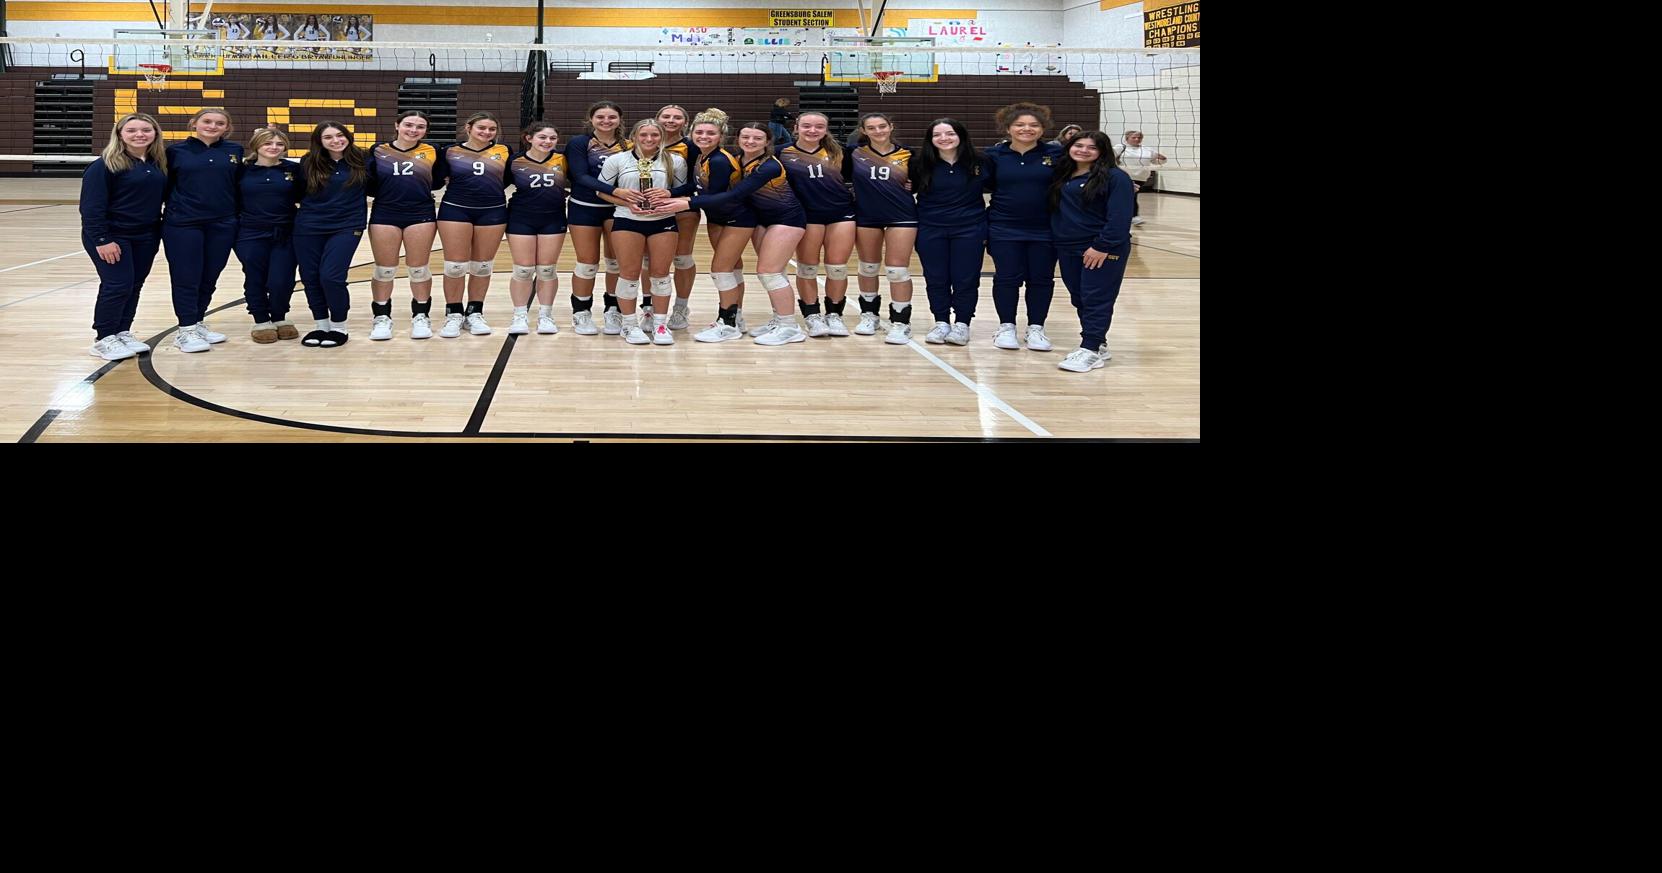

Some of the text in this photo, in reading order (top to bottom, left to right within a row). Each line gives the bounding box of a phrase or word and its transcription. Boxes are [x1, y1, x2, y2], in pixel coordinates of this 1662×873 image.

[1148, 3, 1199, 21] WRESTLING
[1144, 12, 1200, 30] WESTMORELAND COUNT
[928, 26, 987, 35] LAUREL
[1148, 23, 1198, 38] CHAMPIONS
[392, 161, 414, 176] 12
[472, 161, 485, 176] 9
[807, 163, 824, 179] 11
[870, 165, 890, 180] 19
[529, 173, 555, 188] 25
